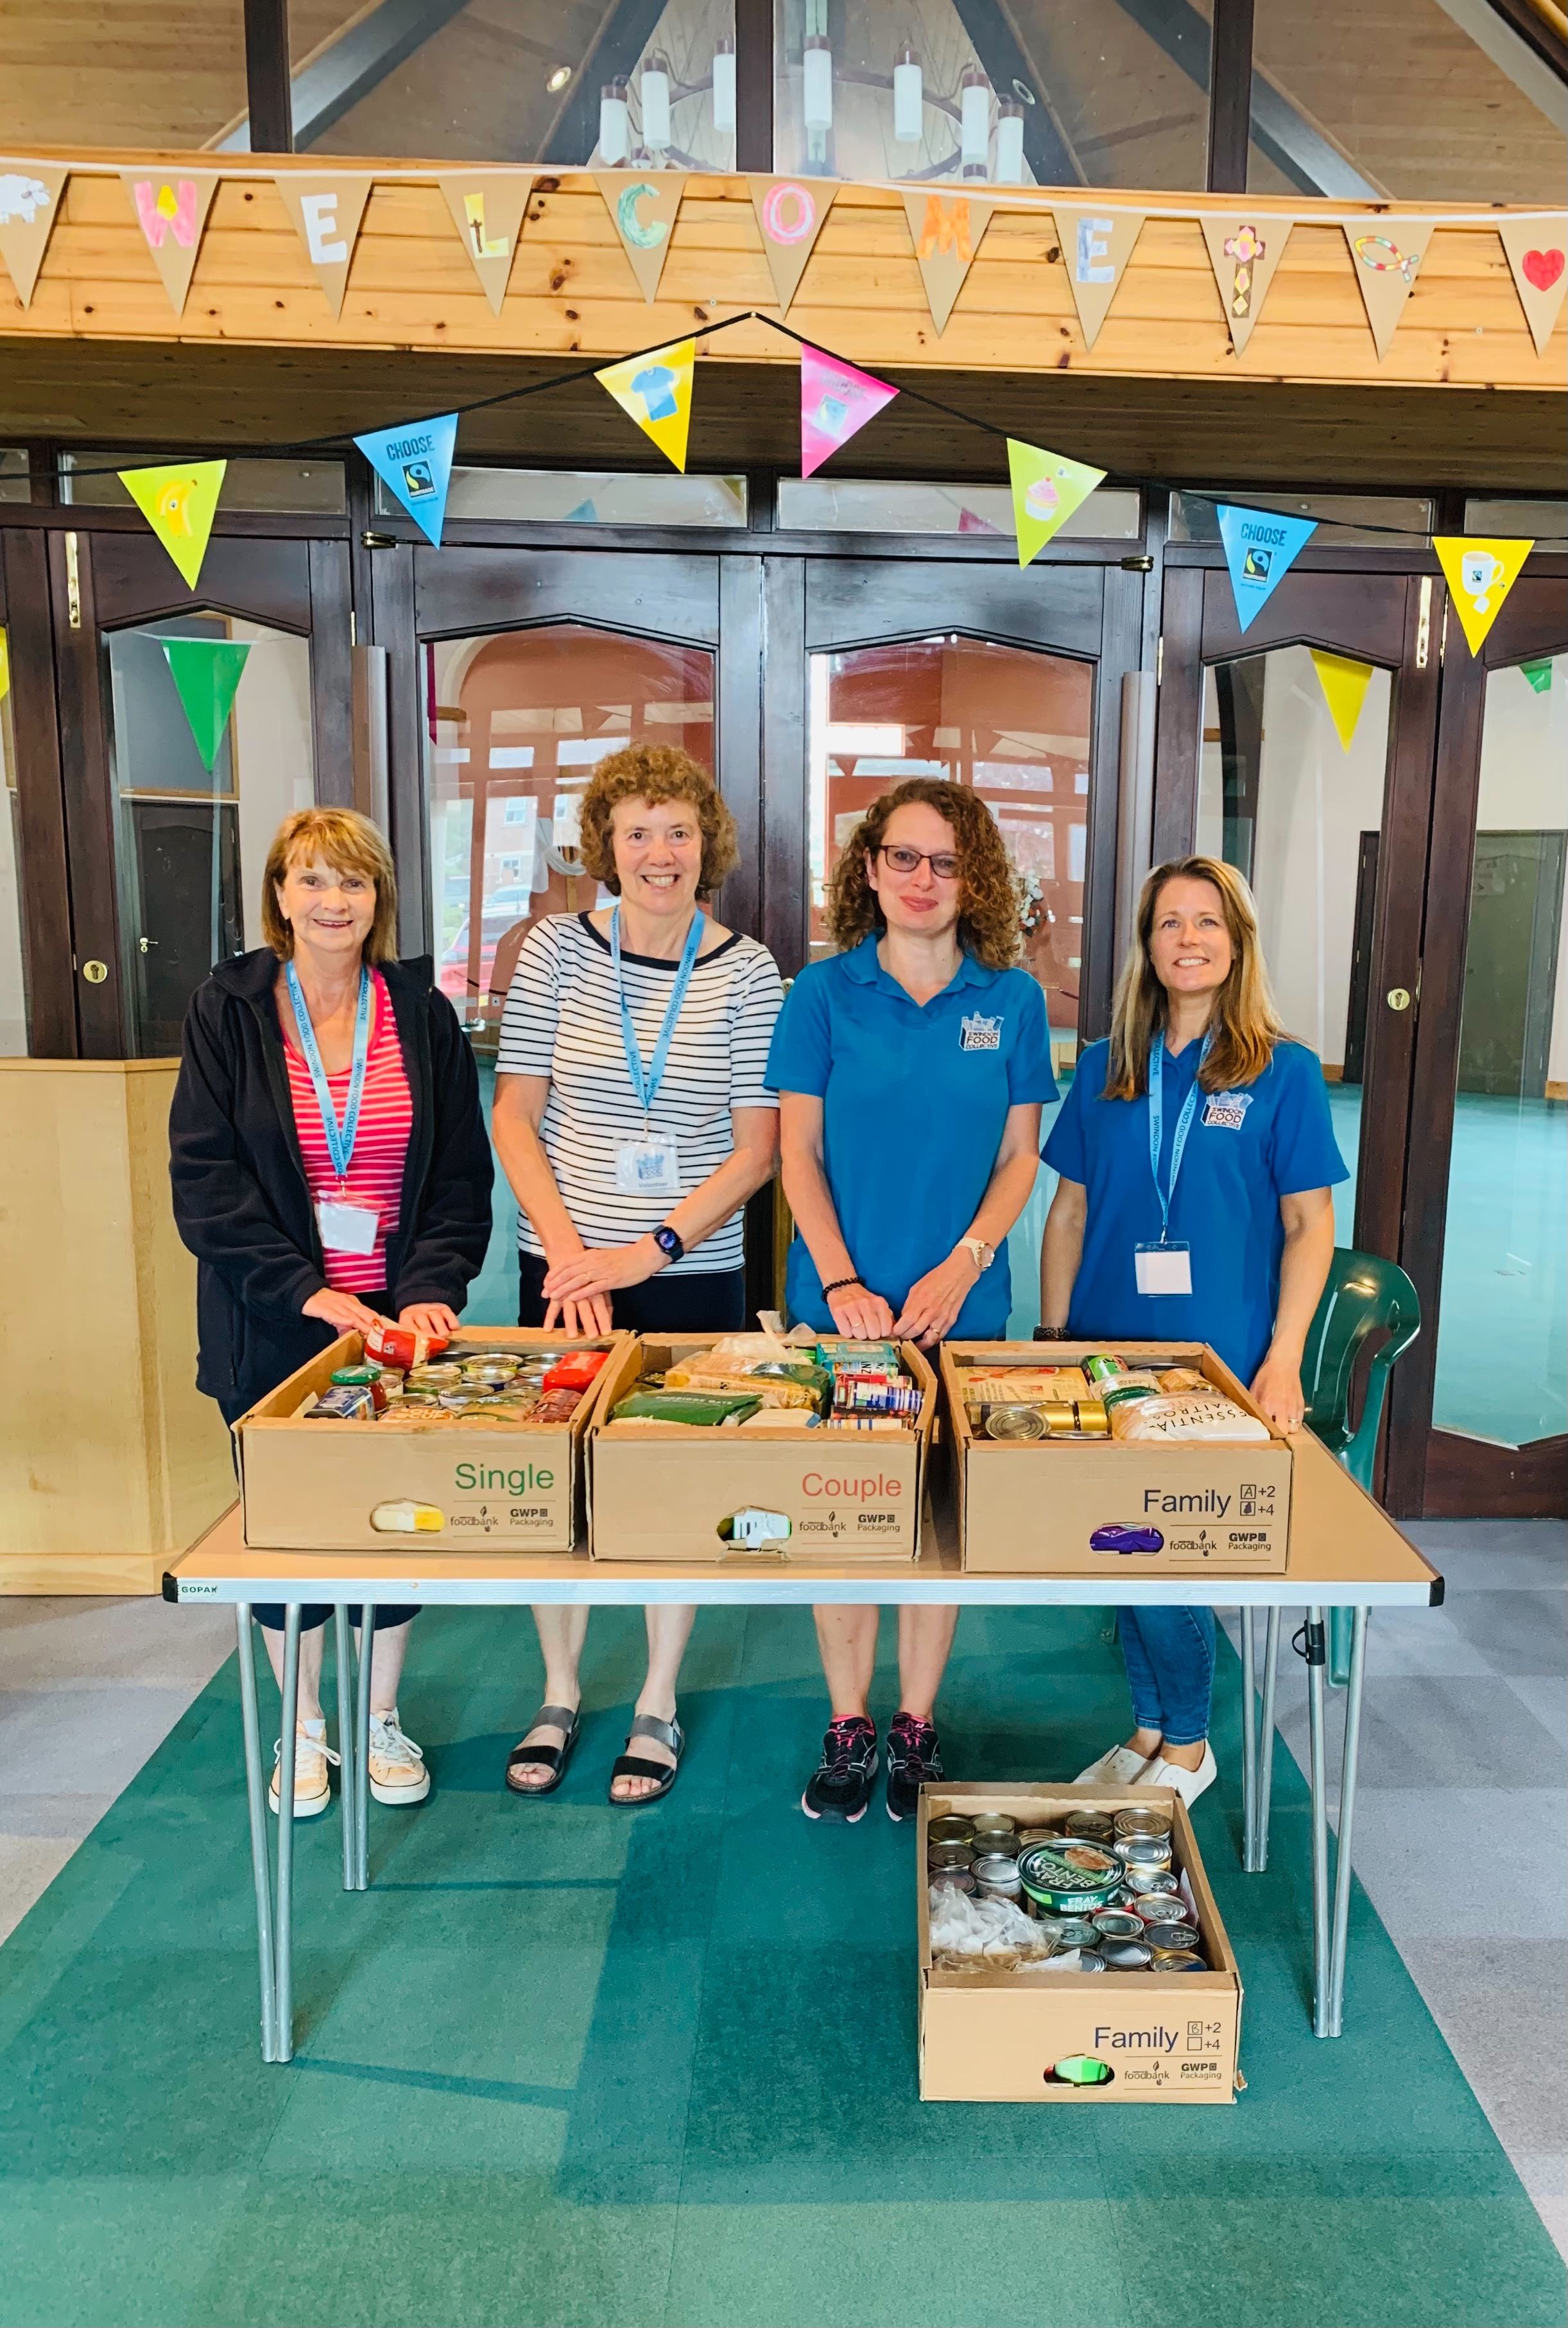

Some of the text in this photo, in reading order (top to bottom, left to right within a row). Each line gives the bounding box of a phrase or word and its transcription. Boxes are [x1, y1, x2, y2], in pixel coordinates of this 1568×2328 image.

[386, 435, 435, 461] CHOOSE
[1241, 523, 1287, 546] CHOOSE
[662, 946, 695, 1038] SWINDON FOOD COLLECTIVE
[301, 1022, 311, 1043] FOOD
[307, 1044, 322, 1078] SWINDON
[1209, 1112, 1241, 1123] FOOD
[326, 1116, 340, 1160] COLLECTIVE
[1171, 1149, 1180, 1186] SWINDON
[1176, 1125, 1185, 1148] FOOD
[456, 1463, 554, 1496] Single
[802, 1473, 901, 1502] Couple
[1243, 1486, 1253, 1498] A
[1259, 1486, 1275, 1497] +2
[1144, 1489, 1231, 1518] Family
[510, 1509, 538, 1517] GWP
[1258, 1504, 1274, 1515] +4
[451, 1516, 498, 1526] foodbank
[510, 1518, 553, 1527] Packaging
[858, 1514, 886, 1523] GWP
[800, 1522, 846, 1531] foodbank
[857, 1524, 900, 1532] Packaging
[1229, 1533, 1257, 1541] GWP
[1169, 1541, 1217, 1550] foodbank
[1228, 1542, 1271, 1551] Packaging
[1040, 1859, 1097, 1888] BENTO
[1031, 1870, 1074, 1890] FRAY
[1067, 1895, 1098, 1905] FRAY
[1060, 1901, 1103, 1912] BENTOS
[1192, 2023, 1200, 2034] B
[1205, 2022, 1221, 2033] +2
[1095, 2026, 1179, 2053] Family
[1205, 2039, 1220, 2049] +4
[1181, 2063, 1208, 2071] GWP
[1124, 2071, 1169, 2080] foodbank
